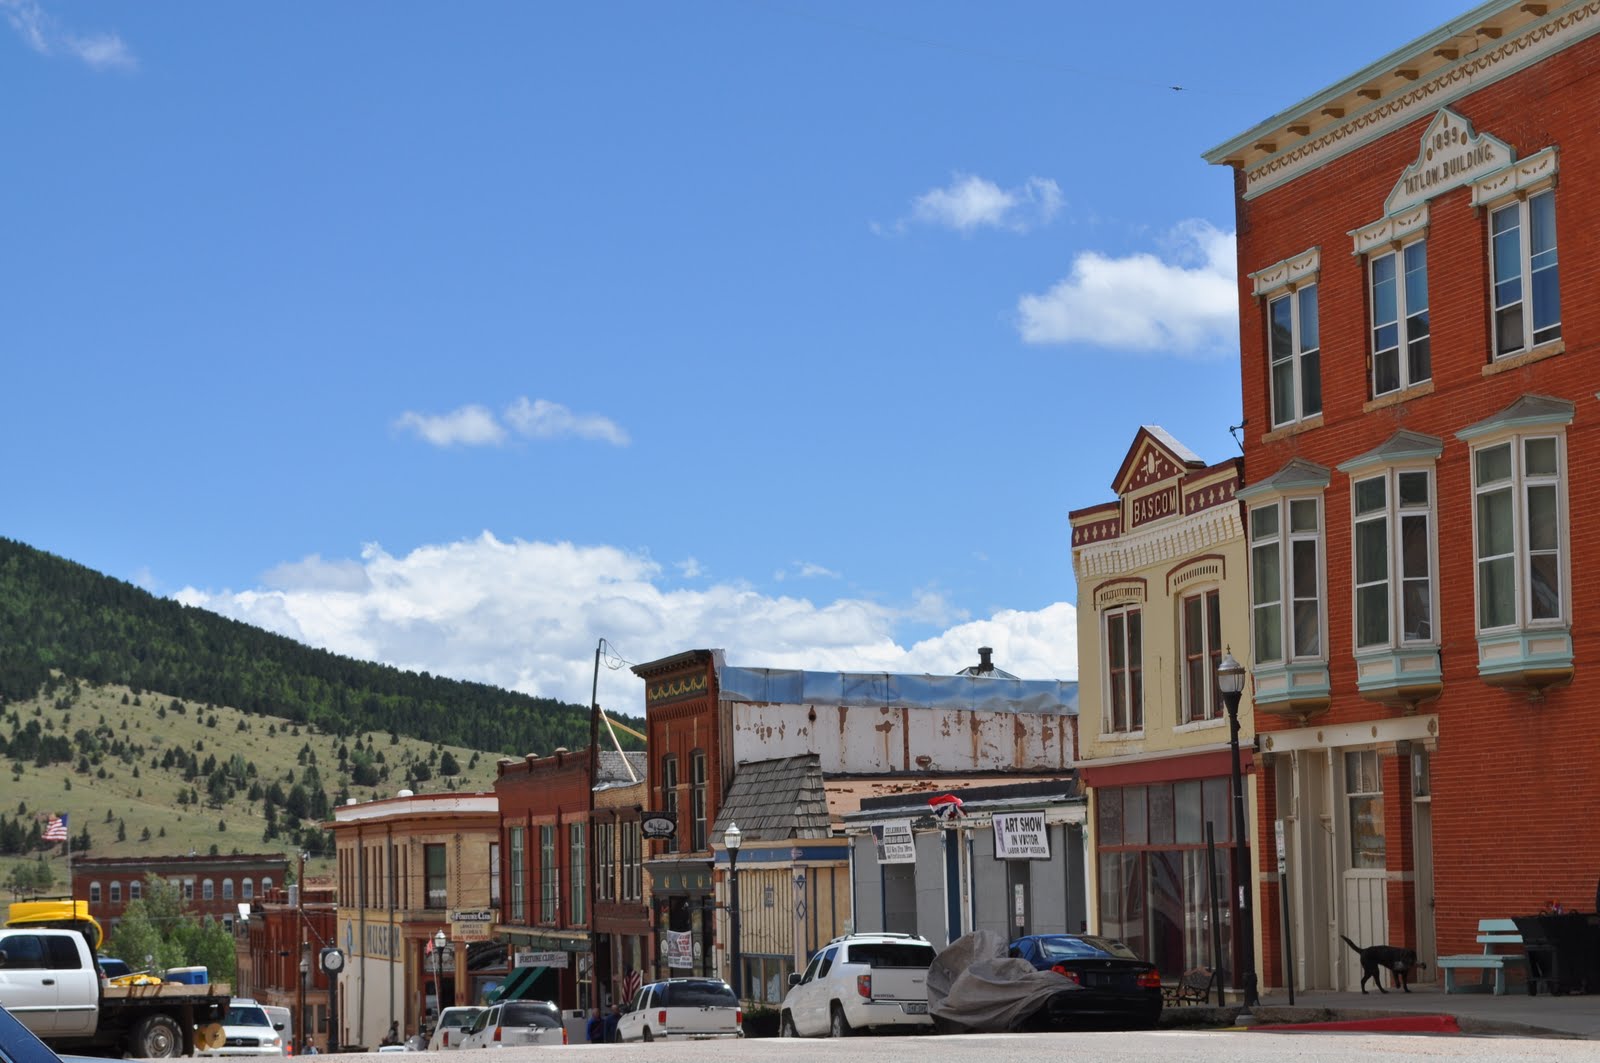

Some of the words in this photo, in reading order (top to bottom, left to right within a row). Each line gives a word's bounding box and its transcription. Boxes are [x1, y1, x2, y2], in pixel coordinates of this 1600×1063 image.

[1432, 126, 1457, 152] 1899
[1134, 489, 1176, 523] BASCOM
[1005, 817, 1018, 832] ART
[1020, 816, 1042, 832] SHOW
[1011, 834, 1018, 846] IN
[1018, 834, 1039, 845] VICTOR
[367, 925, 399, 957] MUSEM
[519, 954, 541, 963] FORTUNE
